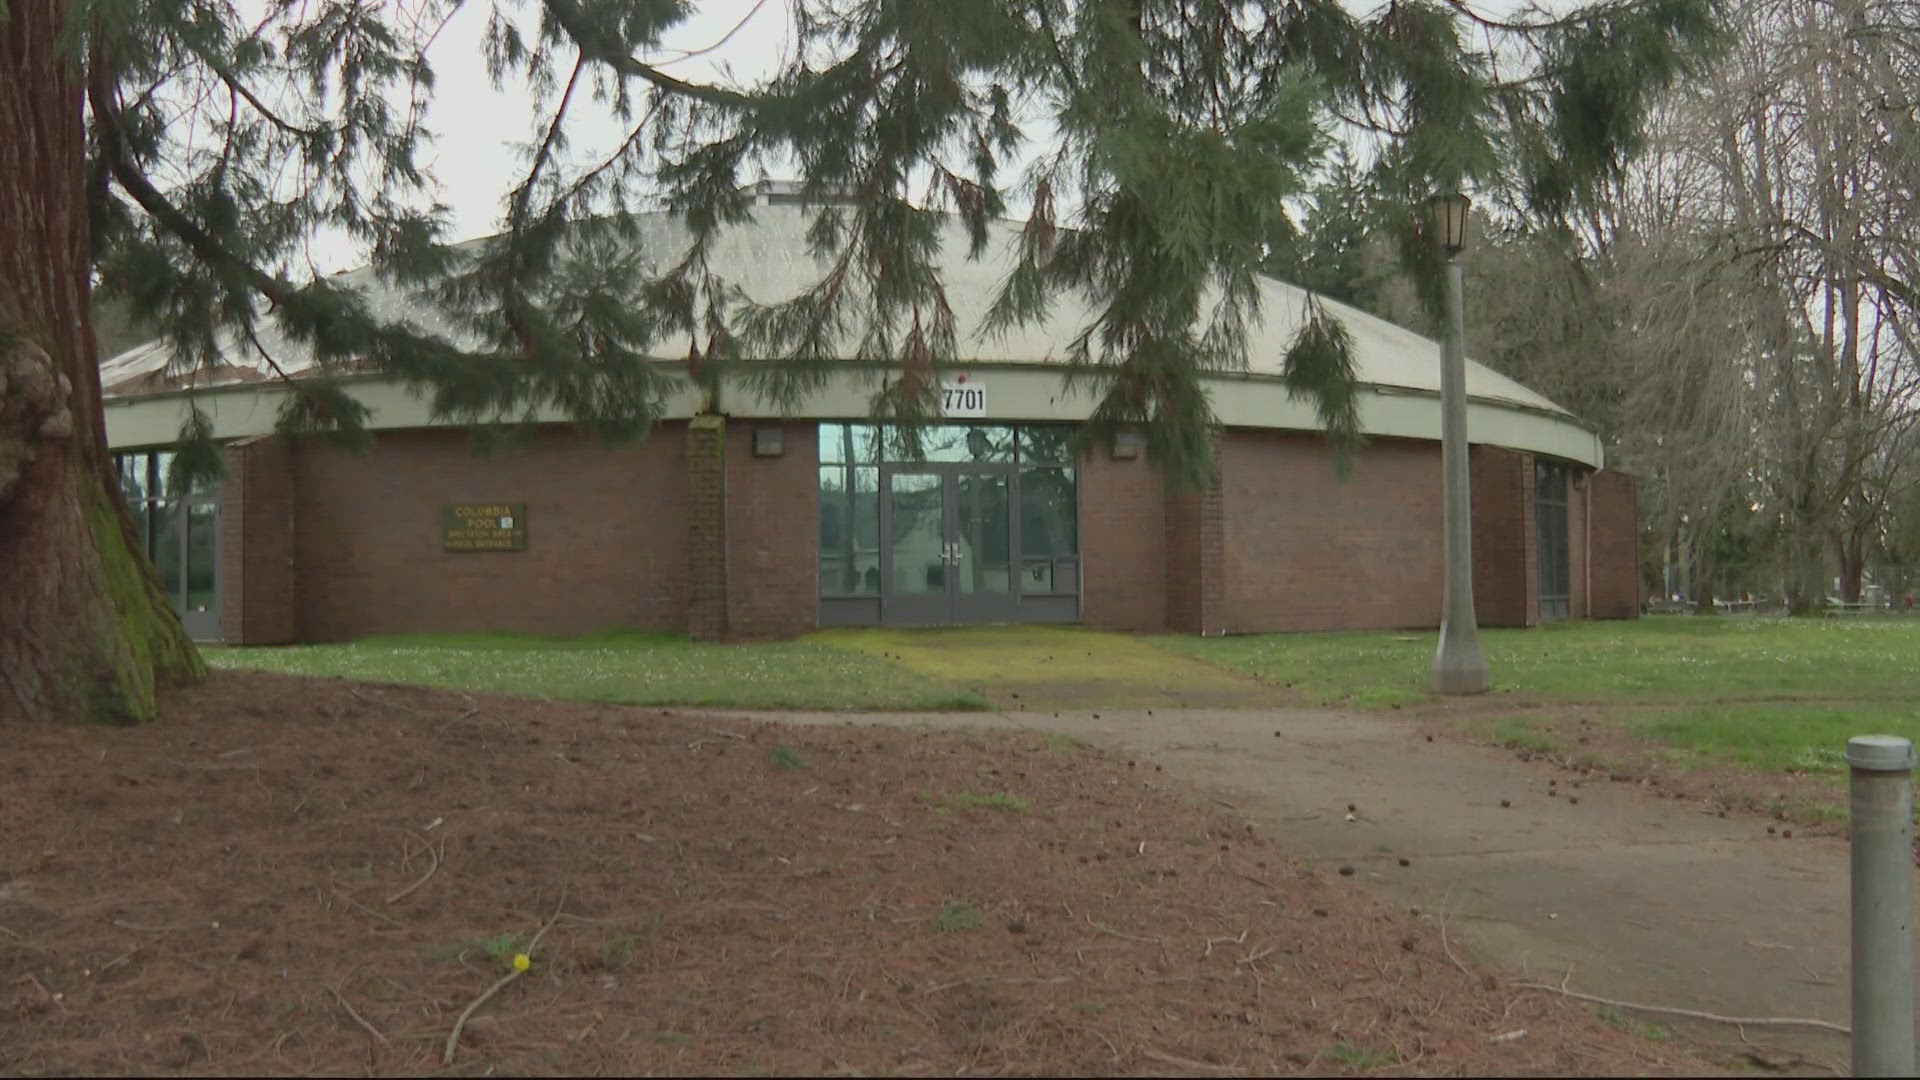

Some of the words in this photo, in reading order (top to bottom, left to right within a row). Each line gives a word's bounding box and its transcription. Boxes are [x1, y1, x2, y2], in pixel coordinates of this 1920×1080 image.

[944, 389, 983, 410] 7701
[455, 506, 512, 517] COLUMBIA
[467, 519, 498, 528] POOL
